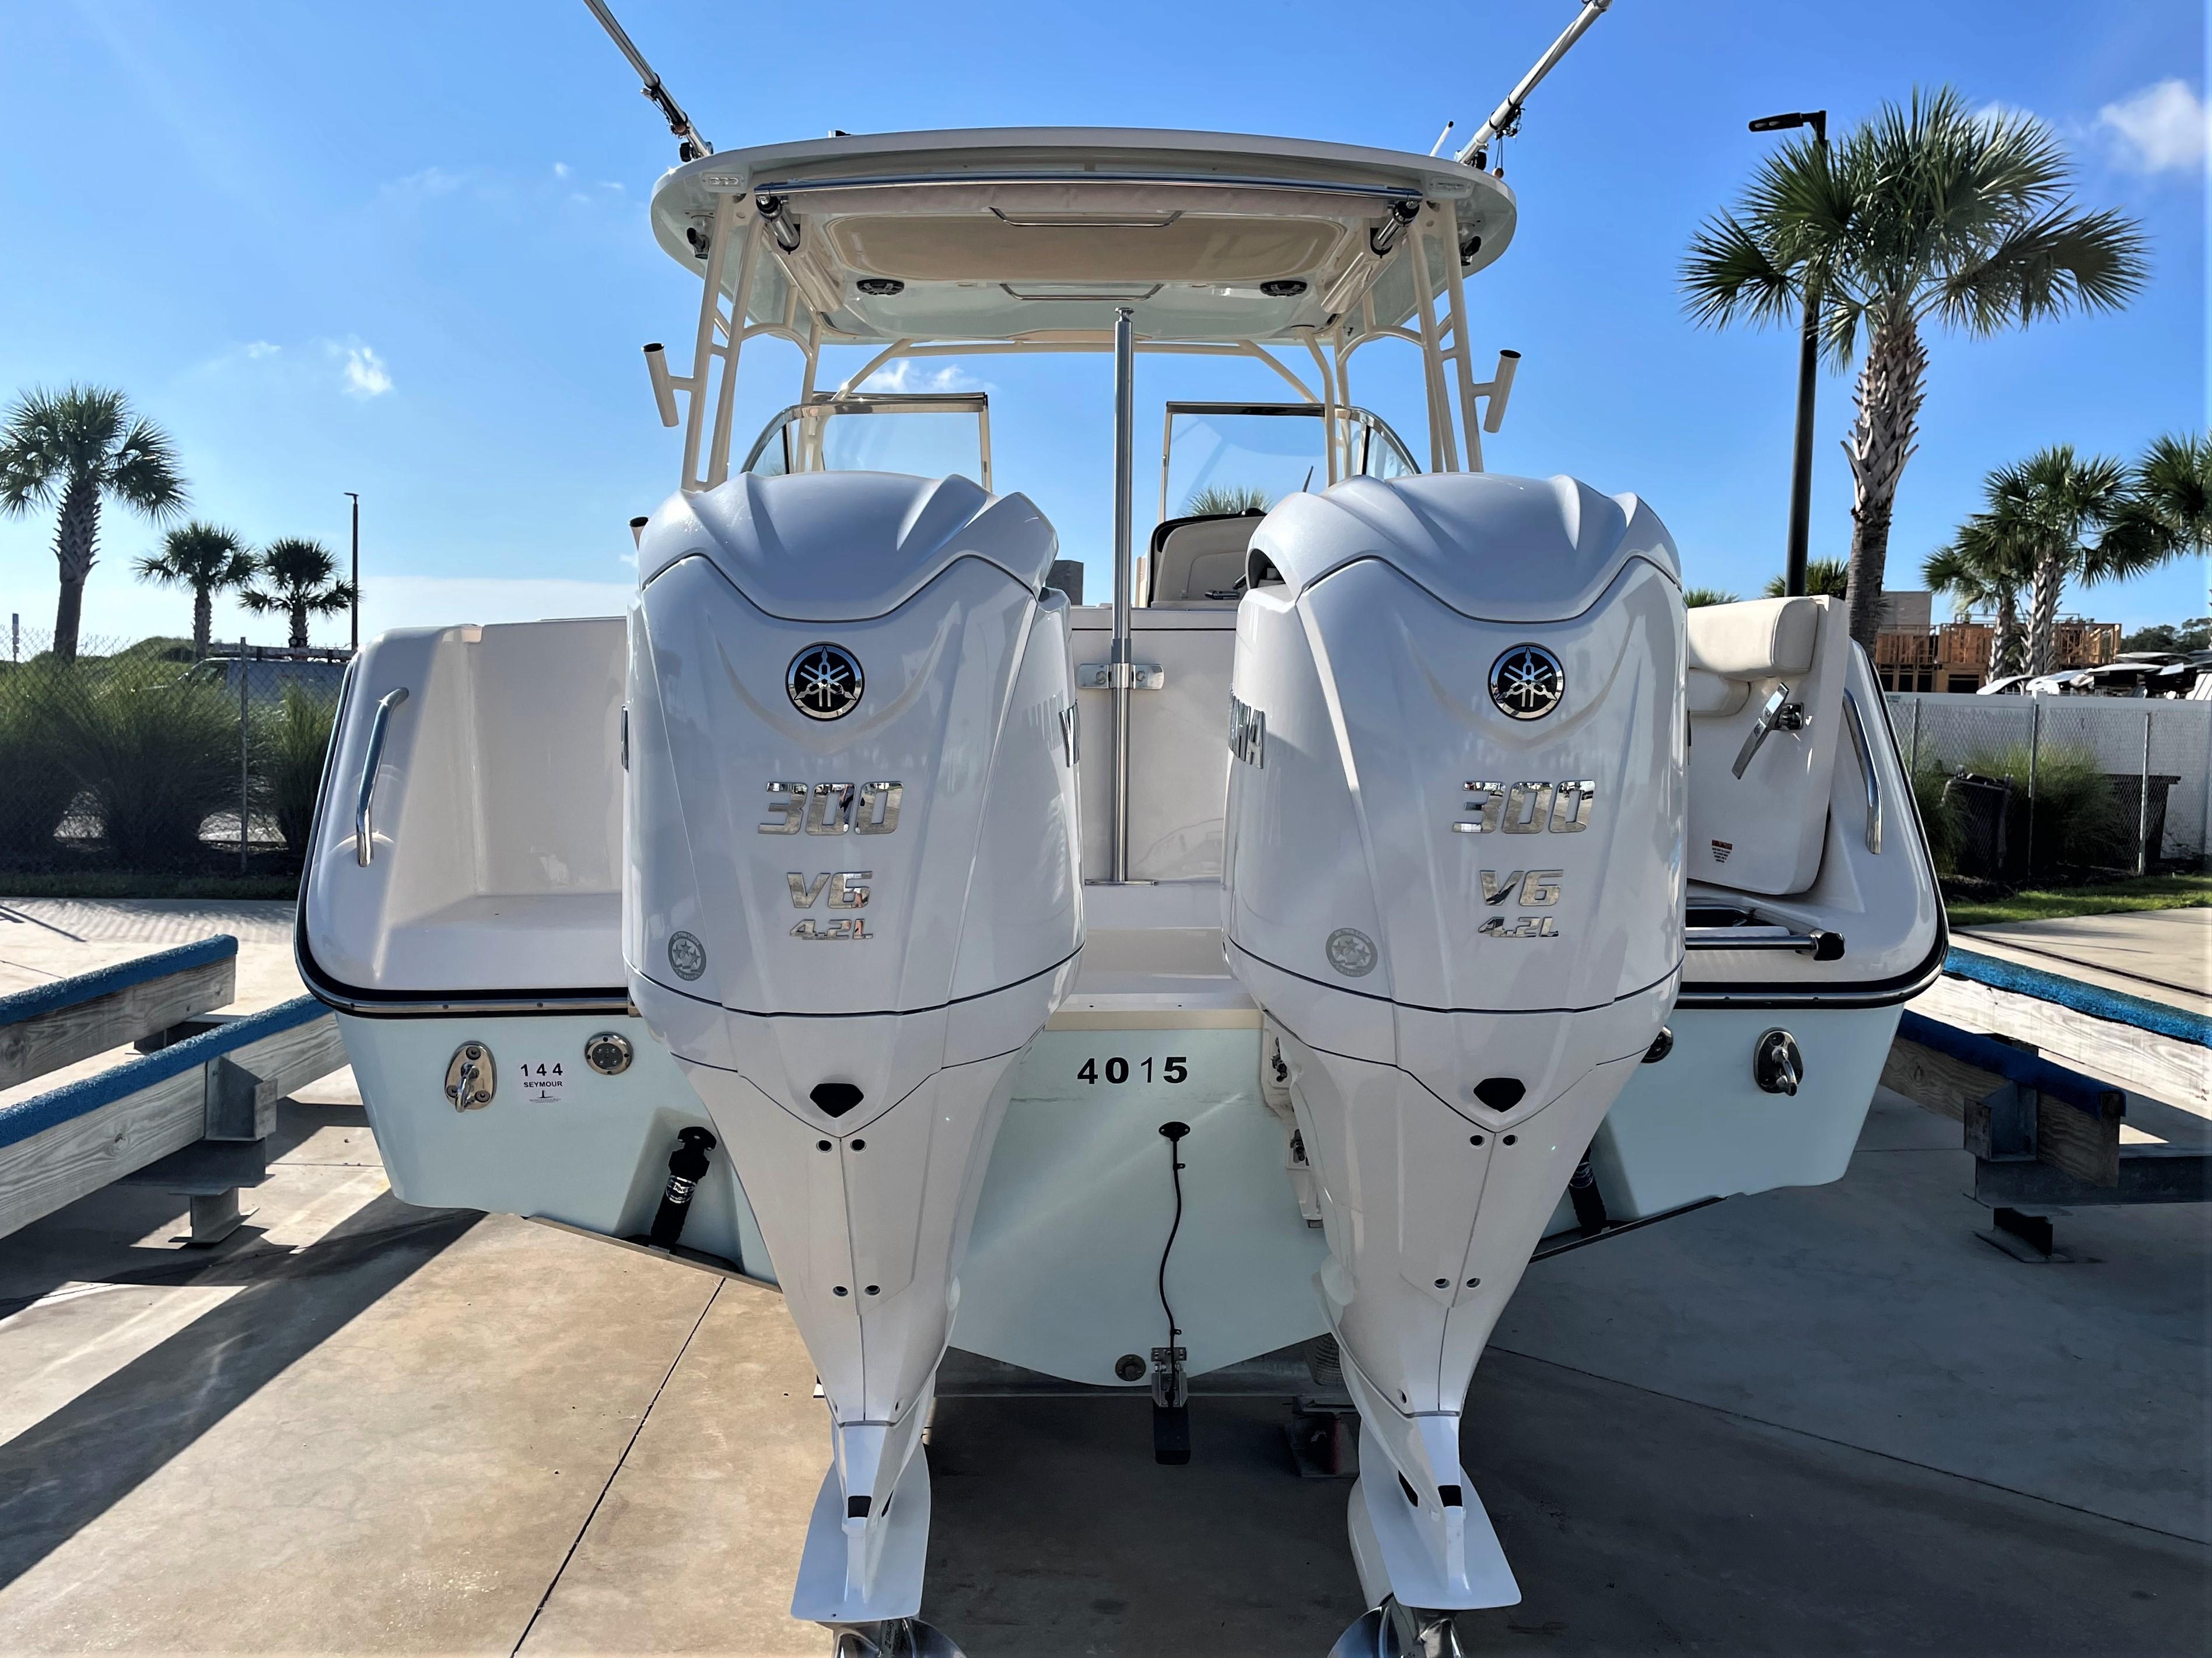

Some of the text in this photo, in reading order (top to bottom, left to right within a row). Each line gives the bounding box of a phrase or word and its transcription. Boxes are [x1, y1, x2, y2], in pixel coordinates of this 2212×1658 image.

[758, 781, 904, 835] 300
[1452, 780, 1595, 833] 300
[787, 871, 873, 909] V6
[1479, 869, 1563, 906] V6
[789, 918, 873, 940] 4.2L
[1478, 916, 1559, 938] 4.2L
[1077, 1056, 1188, 1085] 4015
